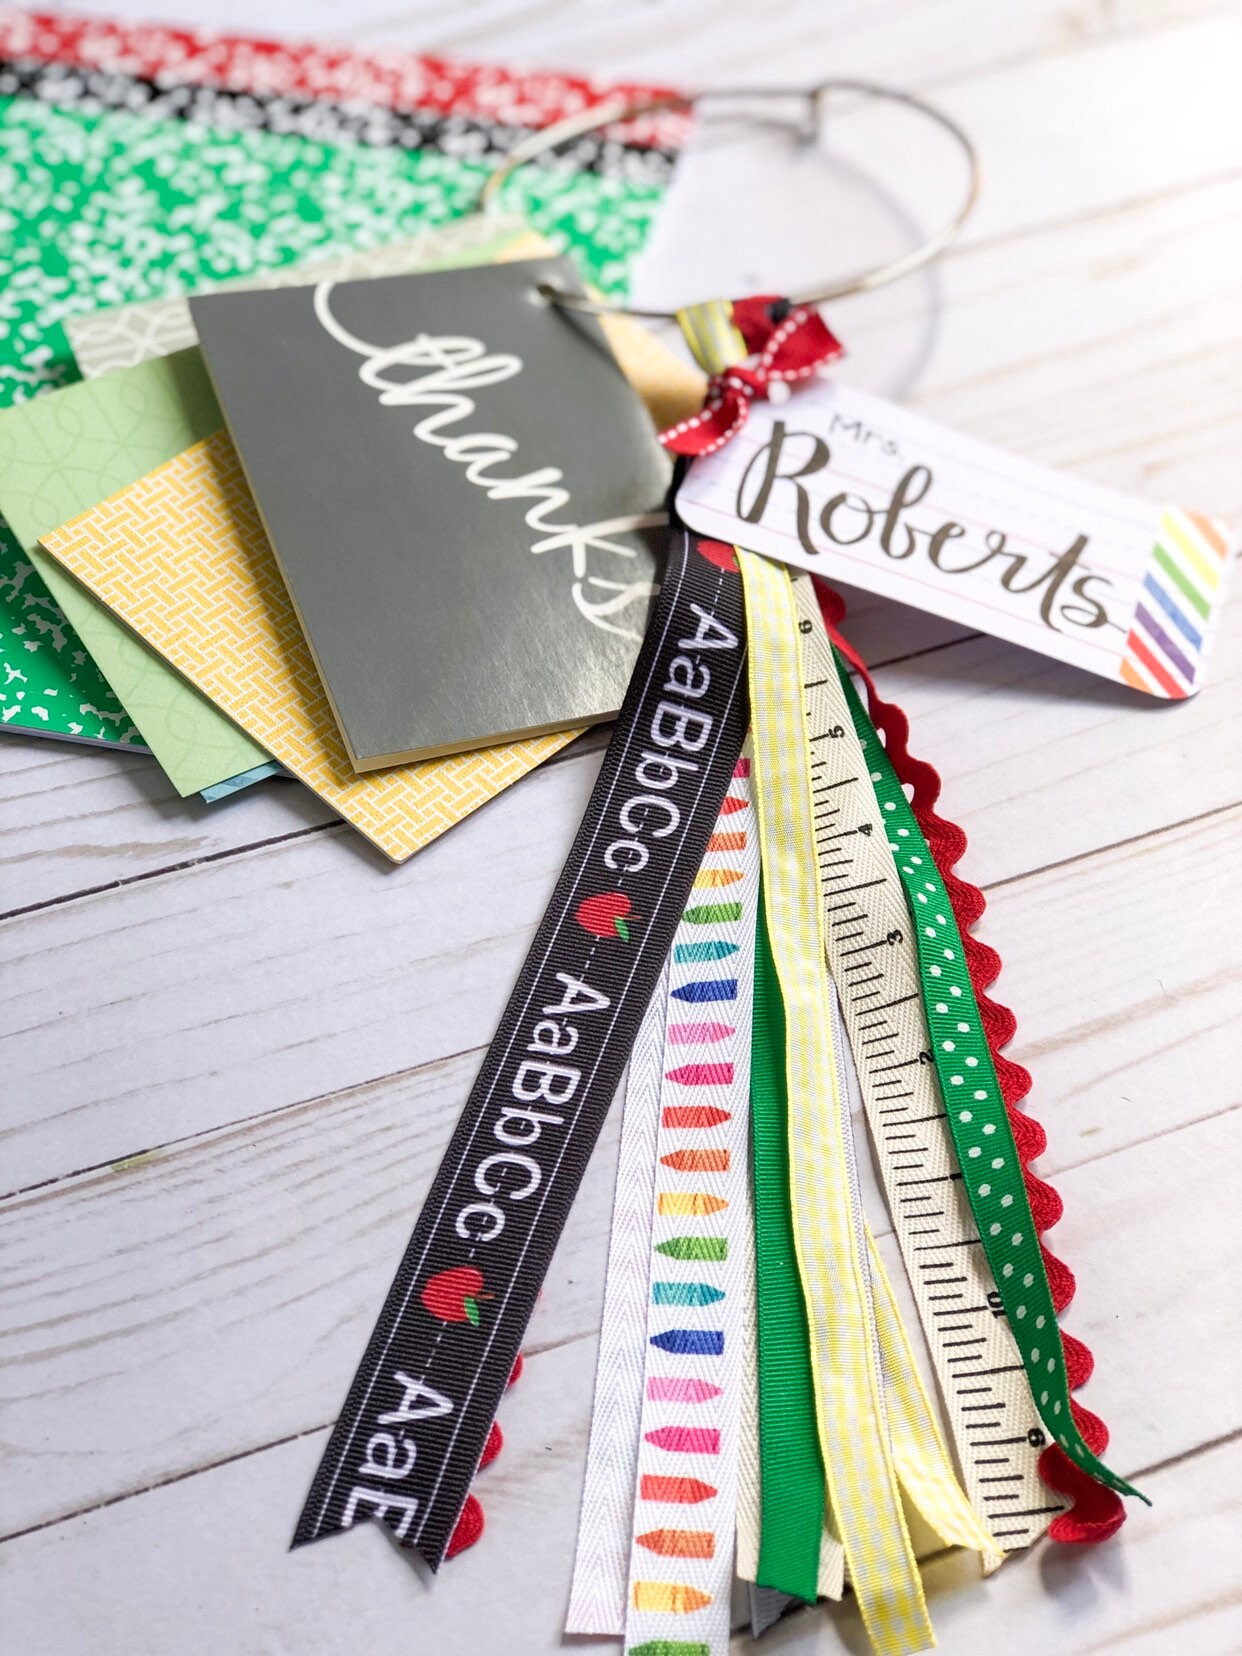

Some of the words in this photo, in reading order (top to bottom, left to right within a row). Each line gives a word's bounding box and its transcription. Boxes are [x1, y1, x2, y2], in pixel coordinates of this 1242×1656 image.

[313, 282, 669, 640] thanks
[735, 420, 1128, 632] Roberts
[604, 603, 739, 874] AaBbCc
[828, 725, 845, 738] 5
[857, 823, 873, 837] 4
[887, 929, 904, 946] 3
[918, 1048, 934, 1065] 2
[454, 972, 611, 1243] AaBbCc
[986, 1291, 1006, 1319] 10
